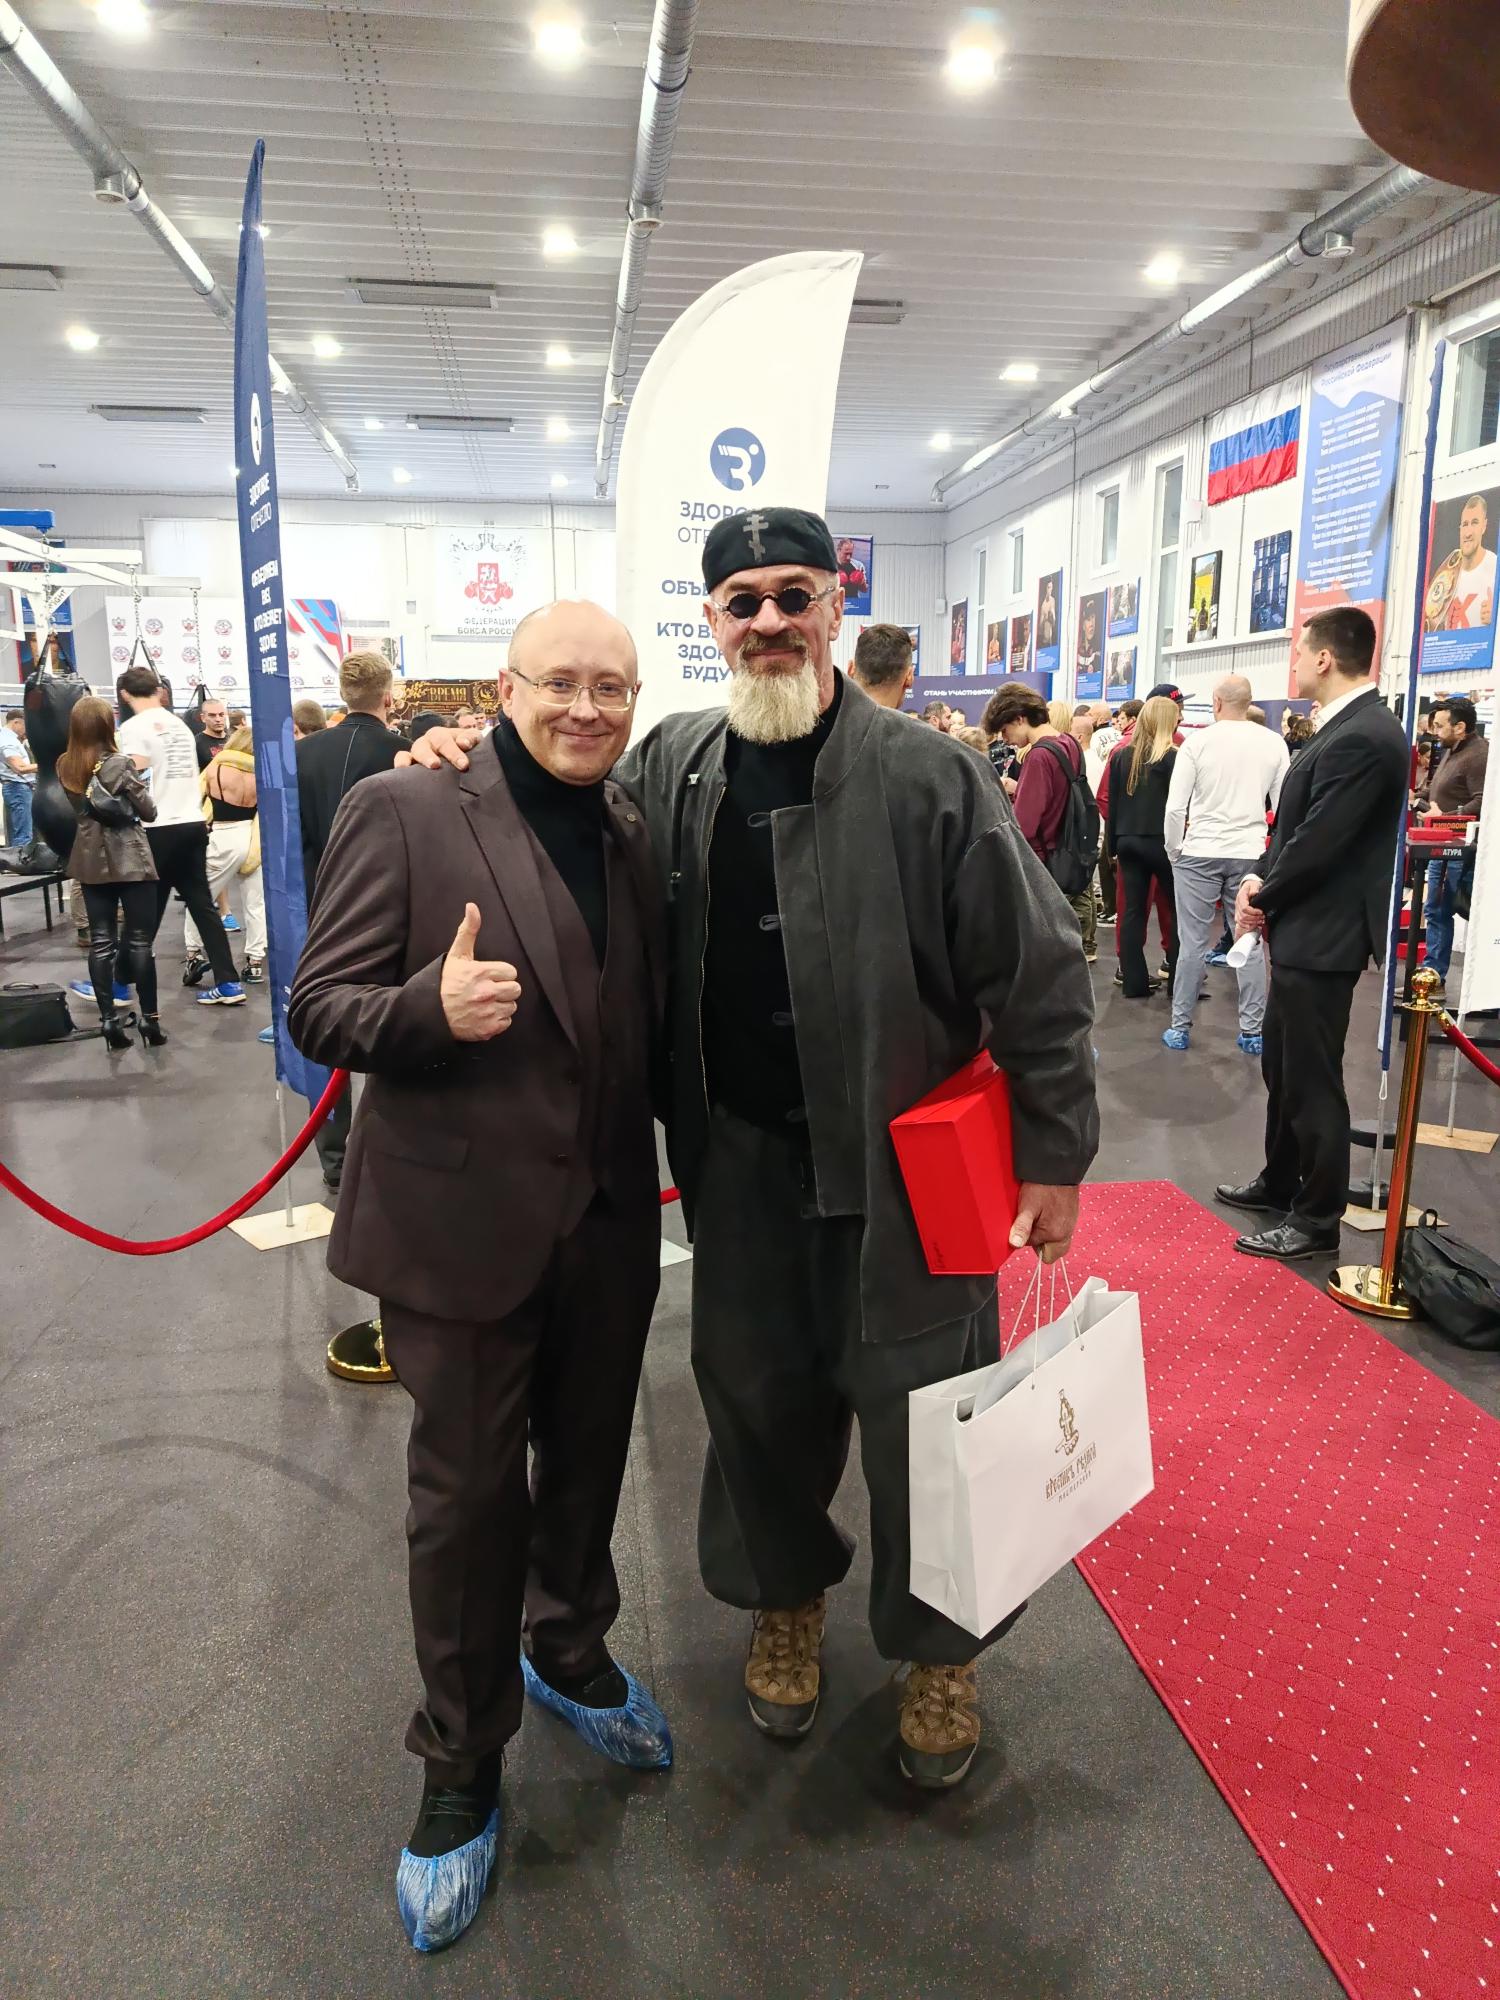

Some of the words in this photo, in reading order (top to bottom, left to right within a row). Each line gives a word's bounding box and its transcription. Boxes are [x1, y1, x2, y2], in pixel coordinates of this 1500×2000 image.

[457, 627, 487, 635] БОКСА
[657, 622, 694, 638] КТО
[429, 687, 467, 701] ВРЕМЯ
